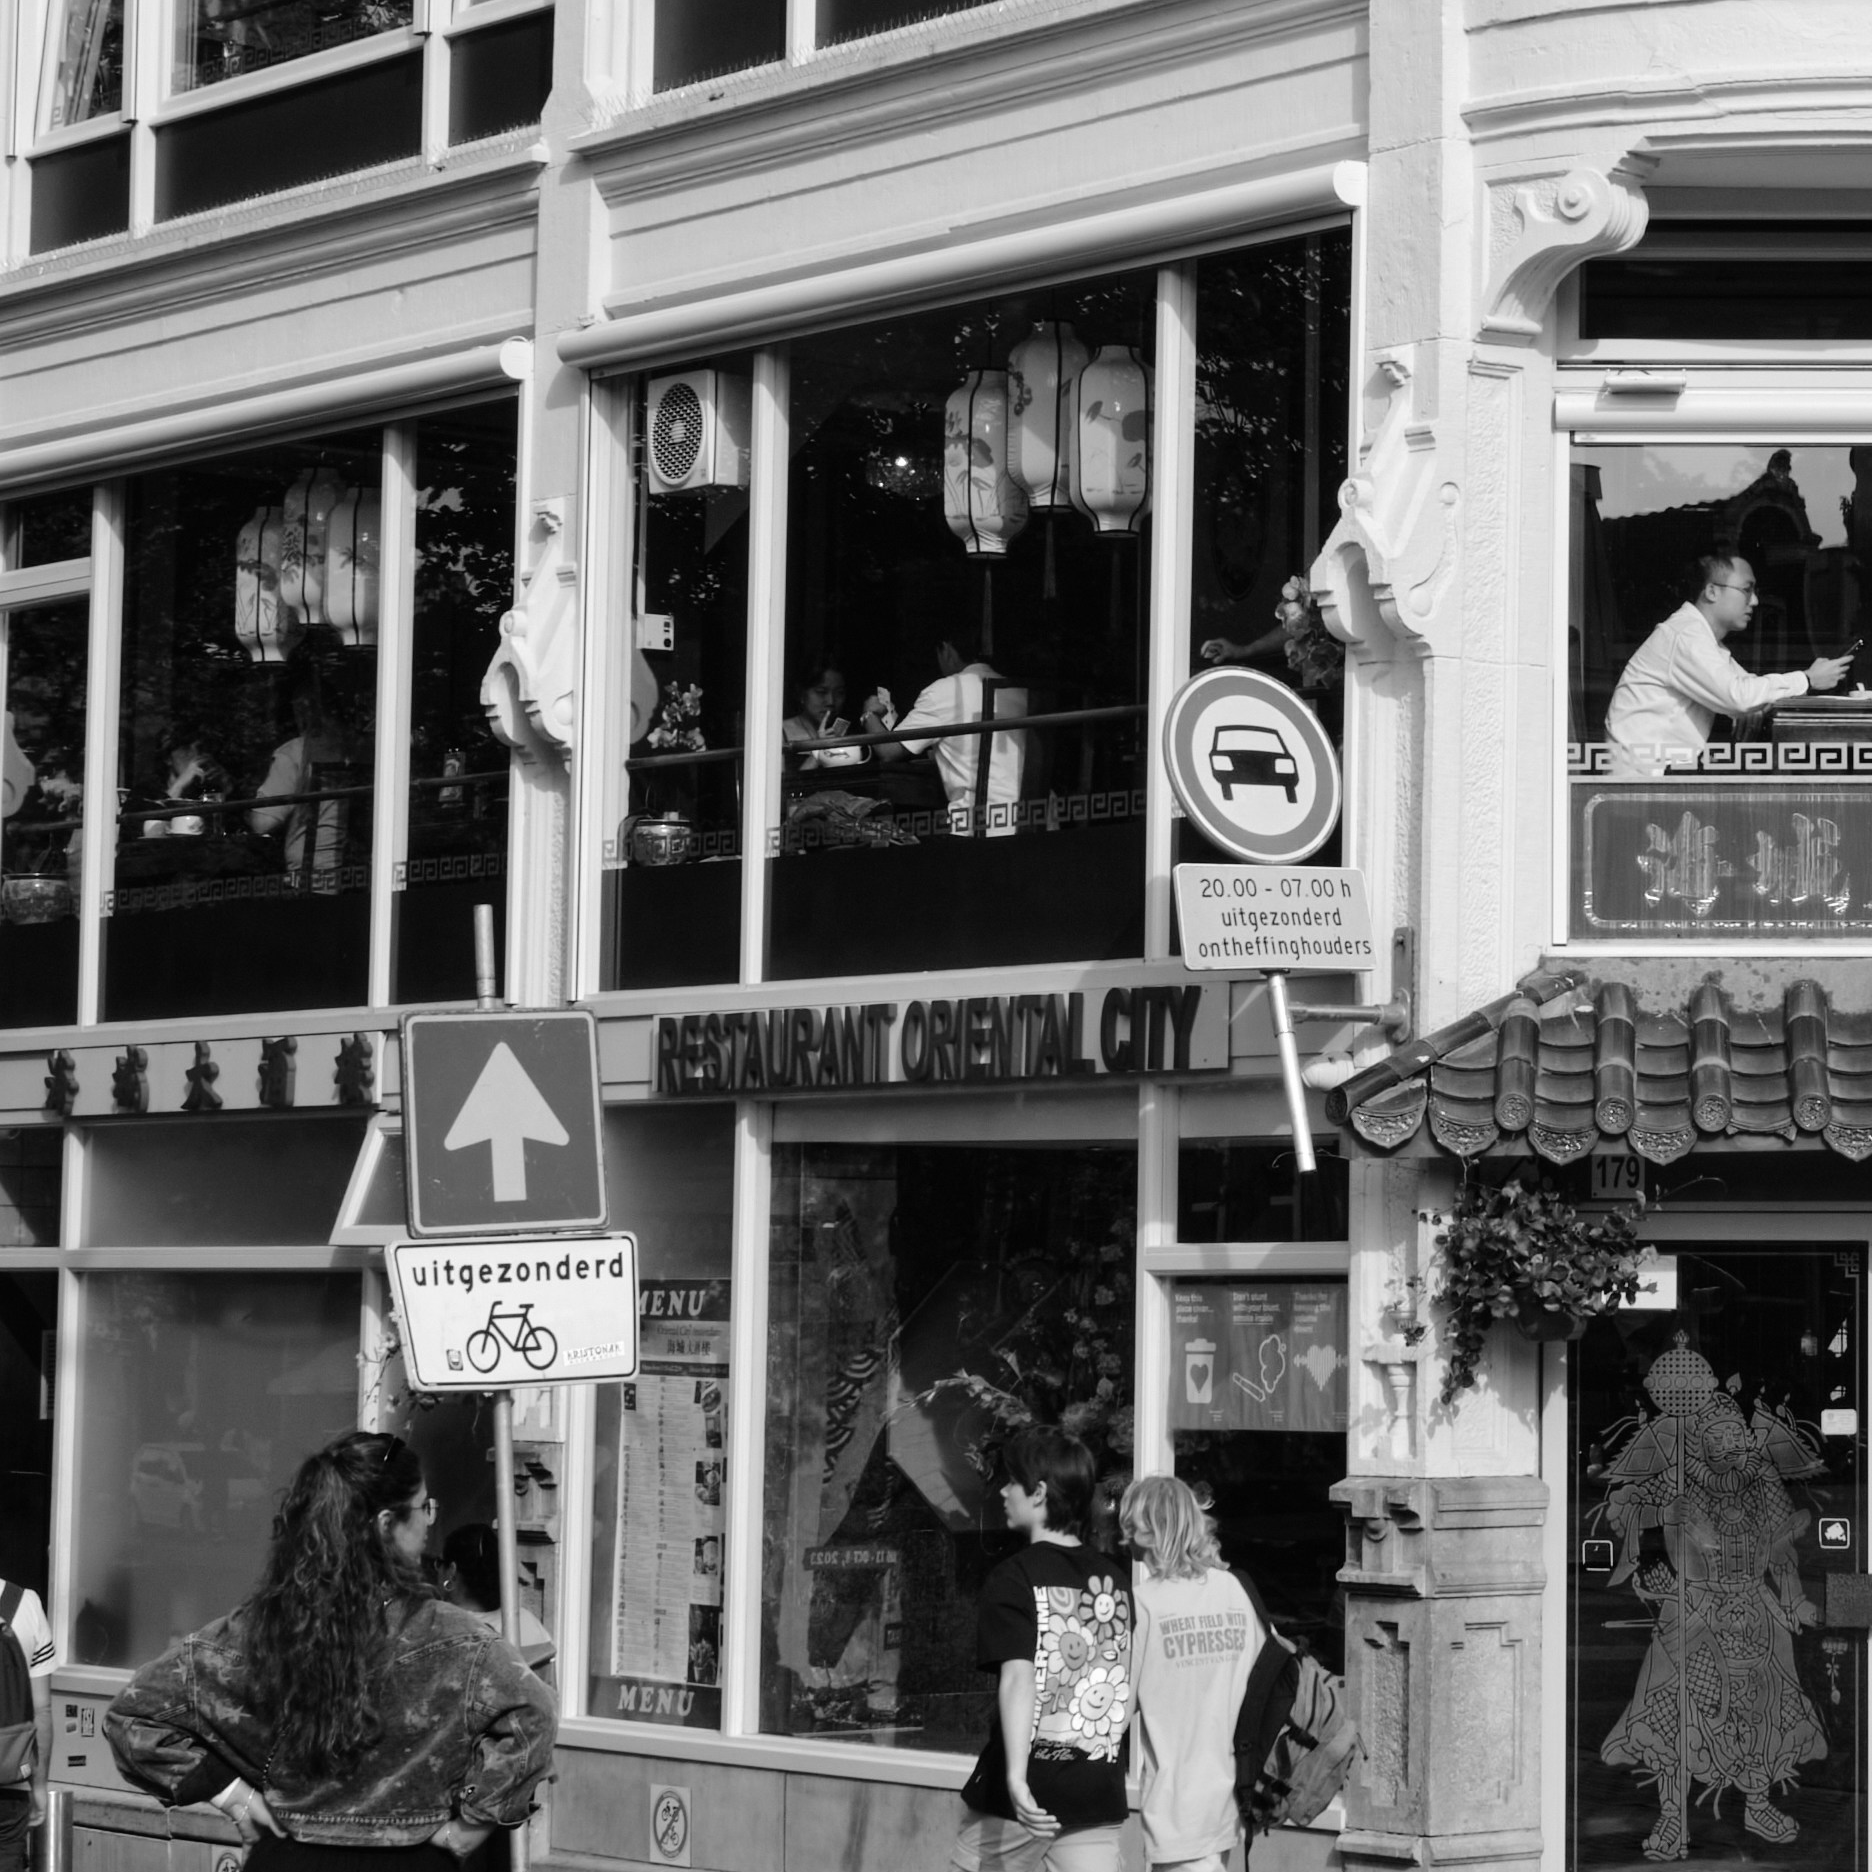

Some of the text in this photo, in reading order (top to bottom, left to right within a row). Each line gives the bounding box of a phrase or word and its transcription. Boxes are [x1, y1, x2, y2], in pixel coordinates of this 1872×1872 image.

[1200, 879, 1257, 898] 20.00
[1280, 879, 1335, 898] 07.00
[1340, 879, 1352, 898] h
[1221, 907, 1342, 932] uitgezonderd
[1199, 936, 1372, 961] ontheffinghouders
[657, 985, 1202, 1093] RESTAURANT ORIENTAL CITY
[1596, 1155, 1642, 1190] 179
[412, 1252, 624, 1294] uitgezonderd
[1159, 1616, 1197, 1636] WHEAT
[1197, 1613, 1224, 1630] FIELD
[1225, 1612, 1247, 1627] WITH
[1162, 1628, 1247, 1660] CYPRESSES
[617, 1684, 696, 1717] MENU
